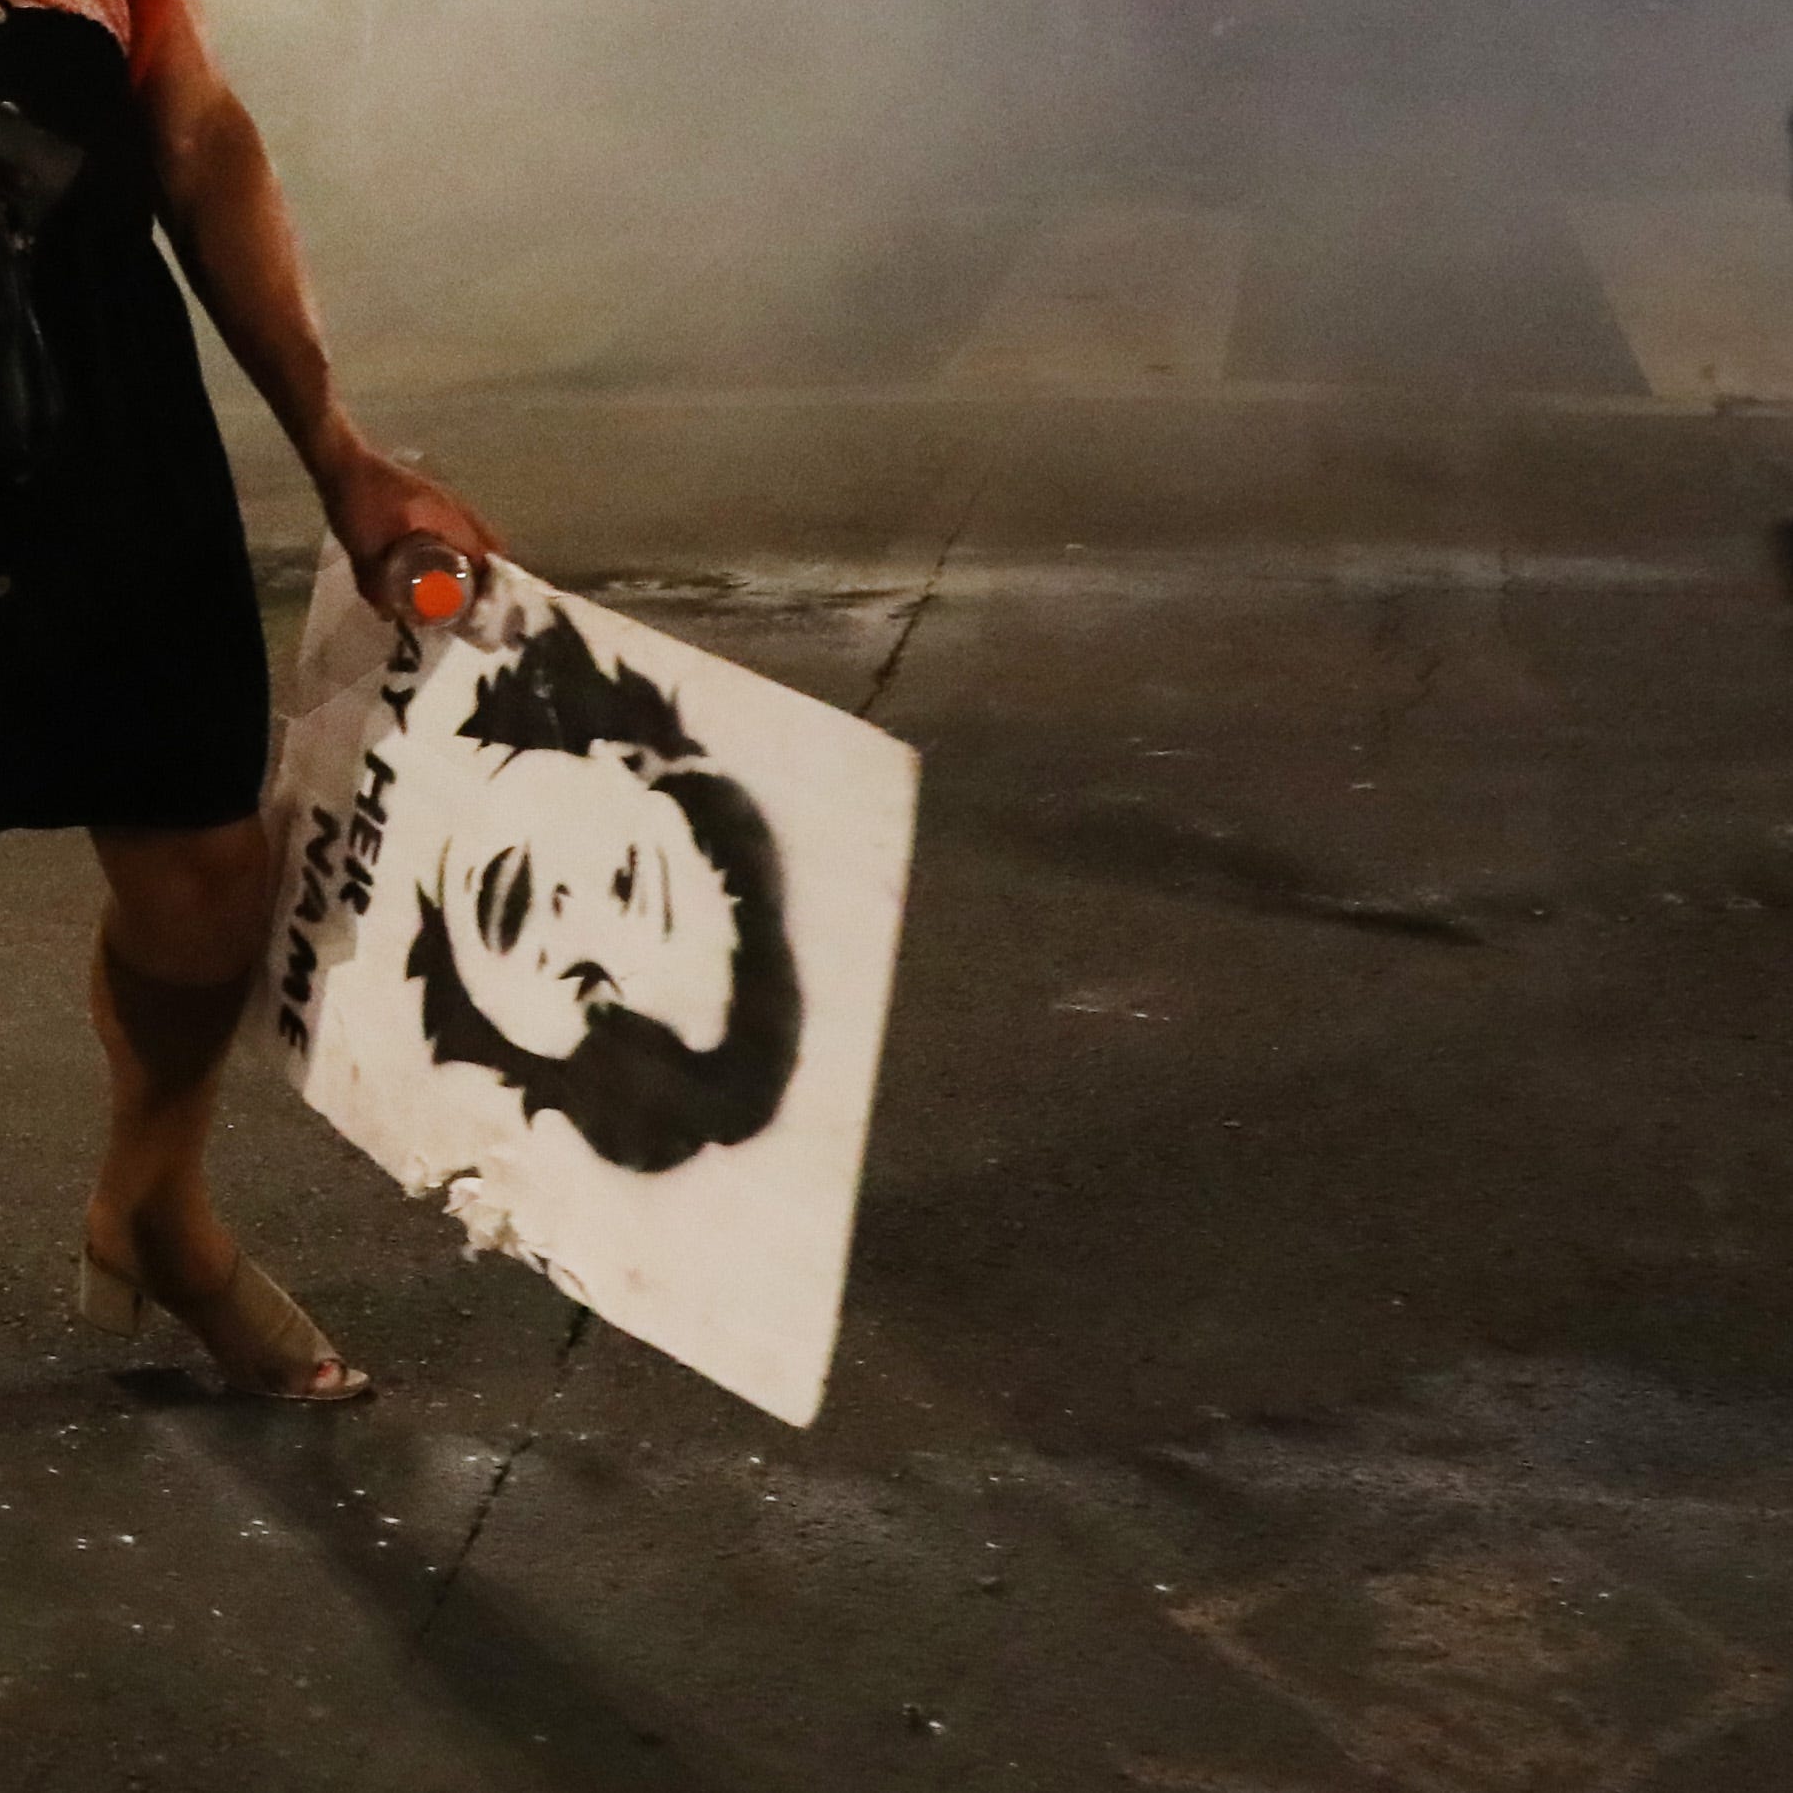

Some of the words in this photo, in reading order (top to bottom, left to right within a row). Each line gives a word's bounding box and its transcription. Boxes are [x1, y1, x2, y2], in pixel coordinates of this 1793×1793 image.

[382, 615, 422, 735] AY
[338, 750, 396, 917] HER
[277, 805, 343, 1055] NAME
